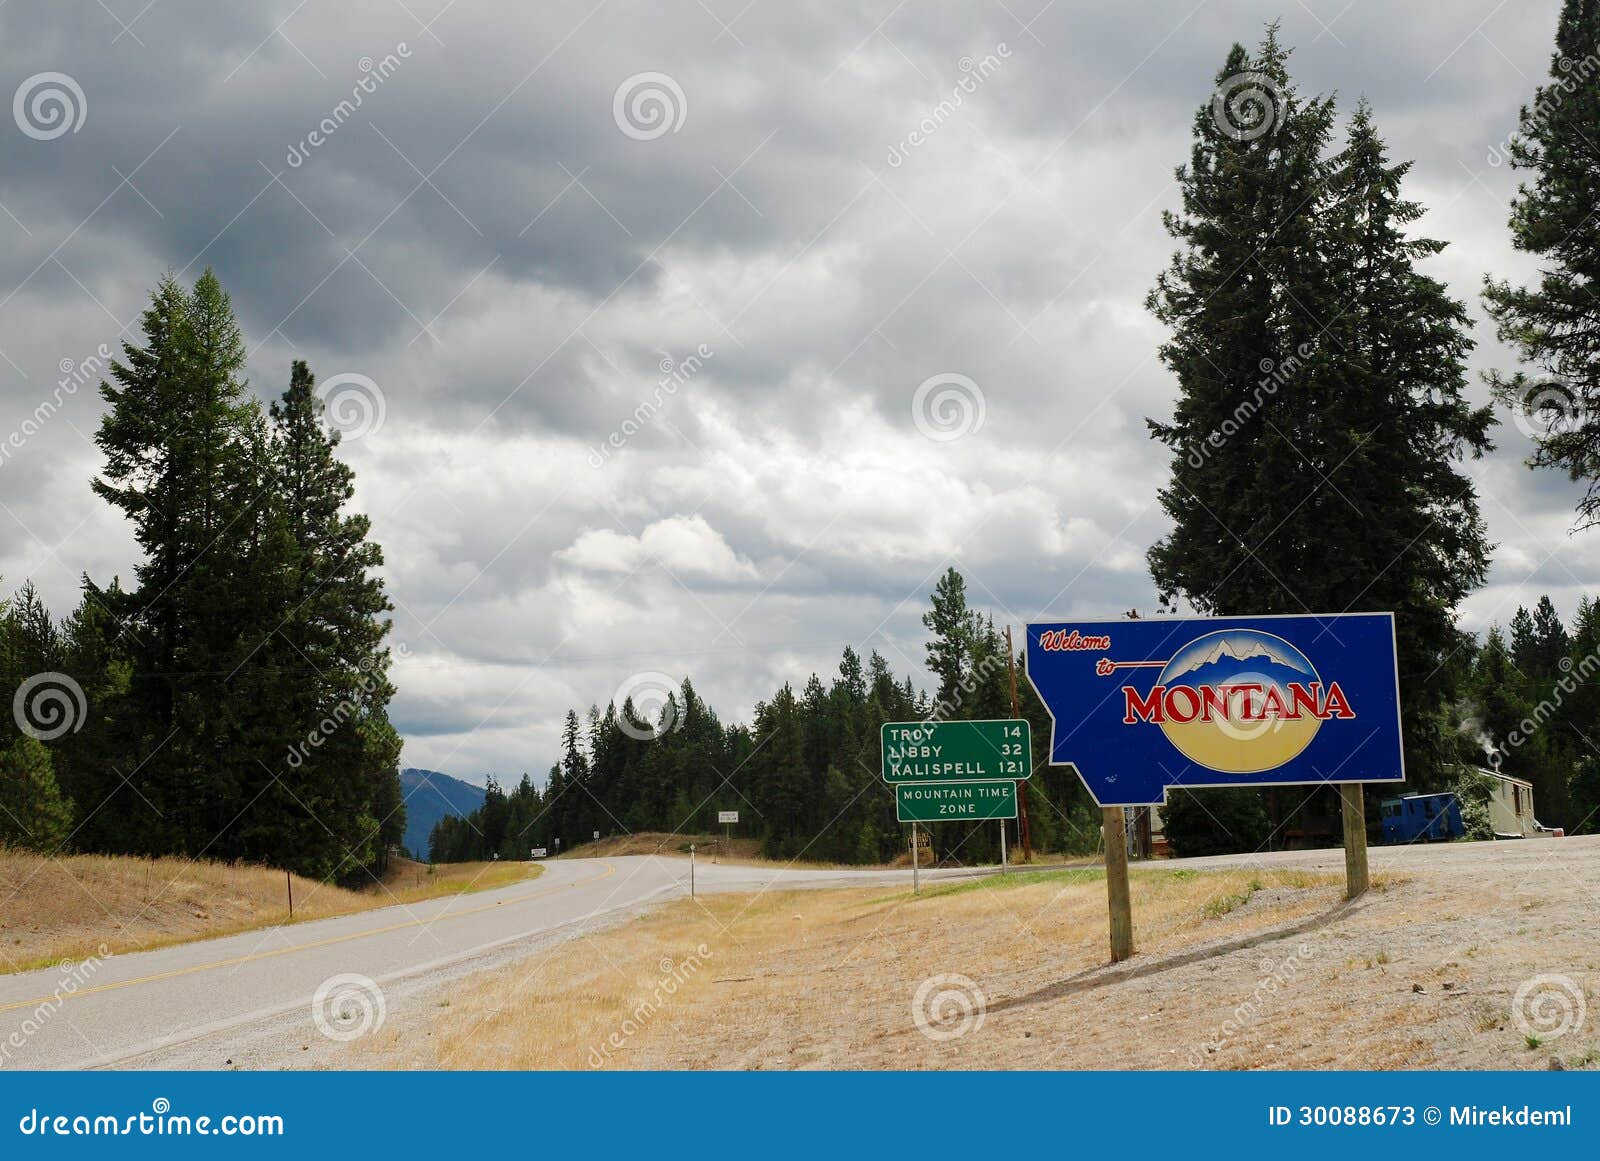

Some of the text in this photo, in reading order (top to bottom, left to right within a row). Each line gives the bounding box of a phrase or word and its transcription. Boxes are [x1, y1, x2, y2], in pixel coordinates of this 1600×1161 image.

[1040, 629, 1112, 651] Welcome
[1096, 658, 1117, 676] to
[1122, 681, 1357, 725] MONTANA
[890, 726, 1021, 741] TROY 14
[890, 744, 1022, 759] LIBBY 32
[891, 761, 1024, 776] KALISPELL 121
[904, 788, 1009, 799] MOUNTAIN TIME
[940, 804, 976, 814] ZONE
